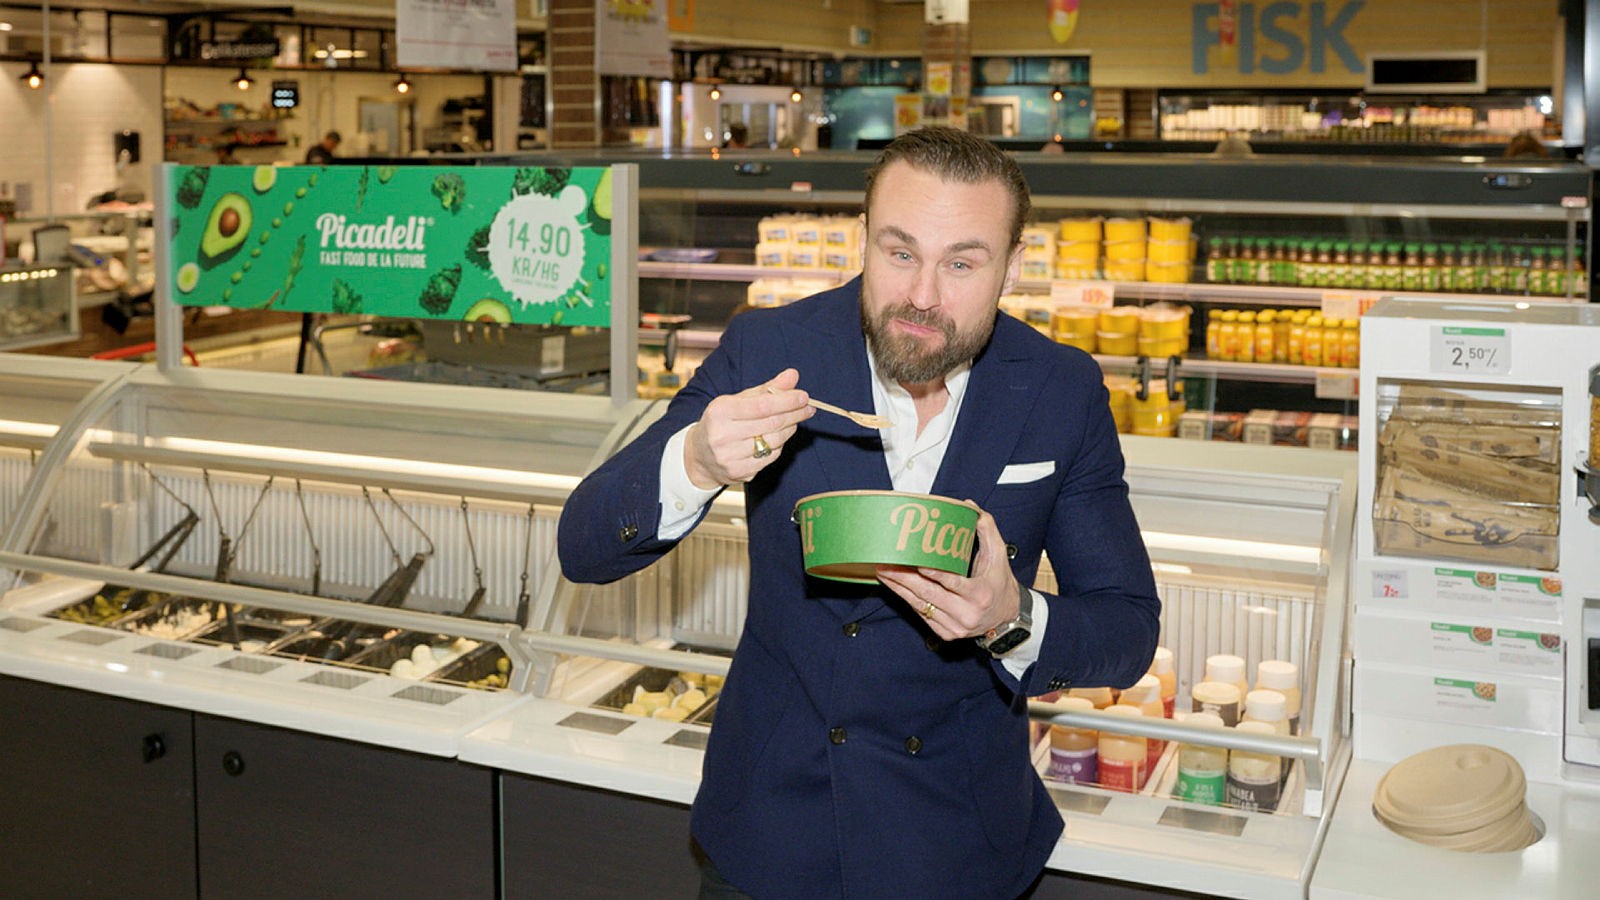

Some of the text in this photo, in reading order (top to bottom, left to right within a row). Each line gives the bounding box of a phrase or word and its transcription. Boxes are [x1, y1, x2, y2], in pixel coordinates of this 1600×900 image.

[1192, 0, 1366, 74] FISK
[316, 213, 426, 250] Picadeli
[508, 218, 571, 257] 14.90
[320, 251, 426, 269] FAST FOOD DE LA FUTURE
[512, 256, 560, 282] KR/HG
[890, 503, 976, 564] Pica
